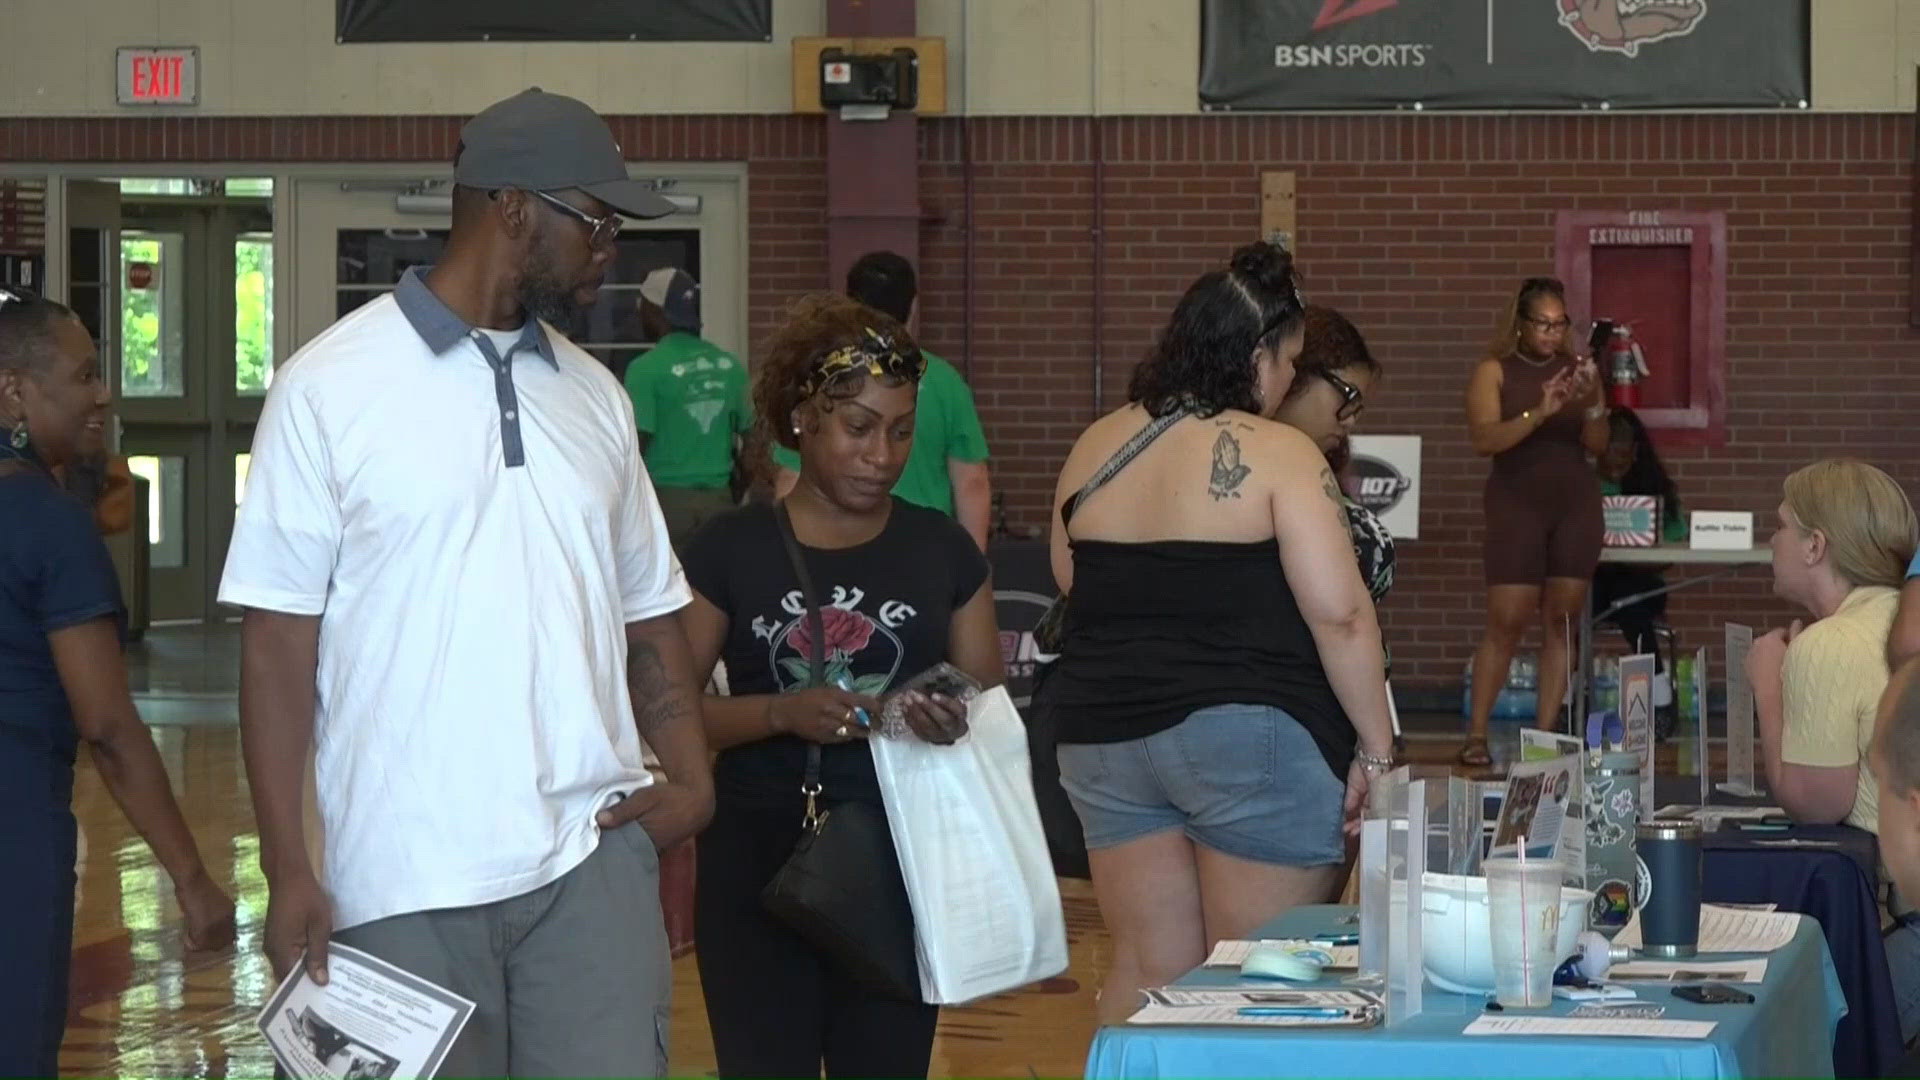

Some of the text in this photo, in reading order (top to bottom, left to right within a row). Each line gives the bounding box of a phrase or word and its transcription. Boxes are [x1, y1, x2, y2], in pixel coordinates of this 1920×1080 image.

[1275, 44, 1426, 67] BSN SPORTS
[132, 56, 184, 97] EXIT
[1628, 210, 1660, 225] FIRE
[1589, 228, 1693, 244] EXTINGUISHER
